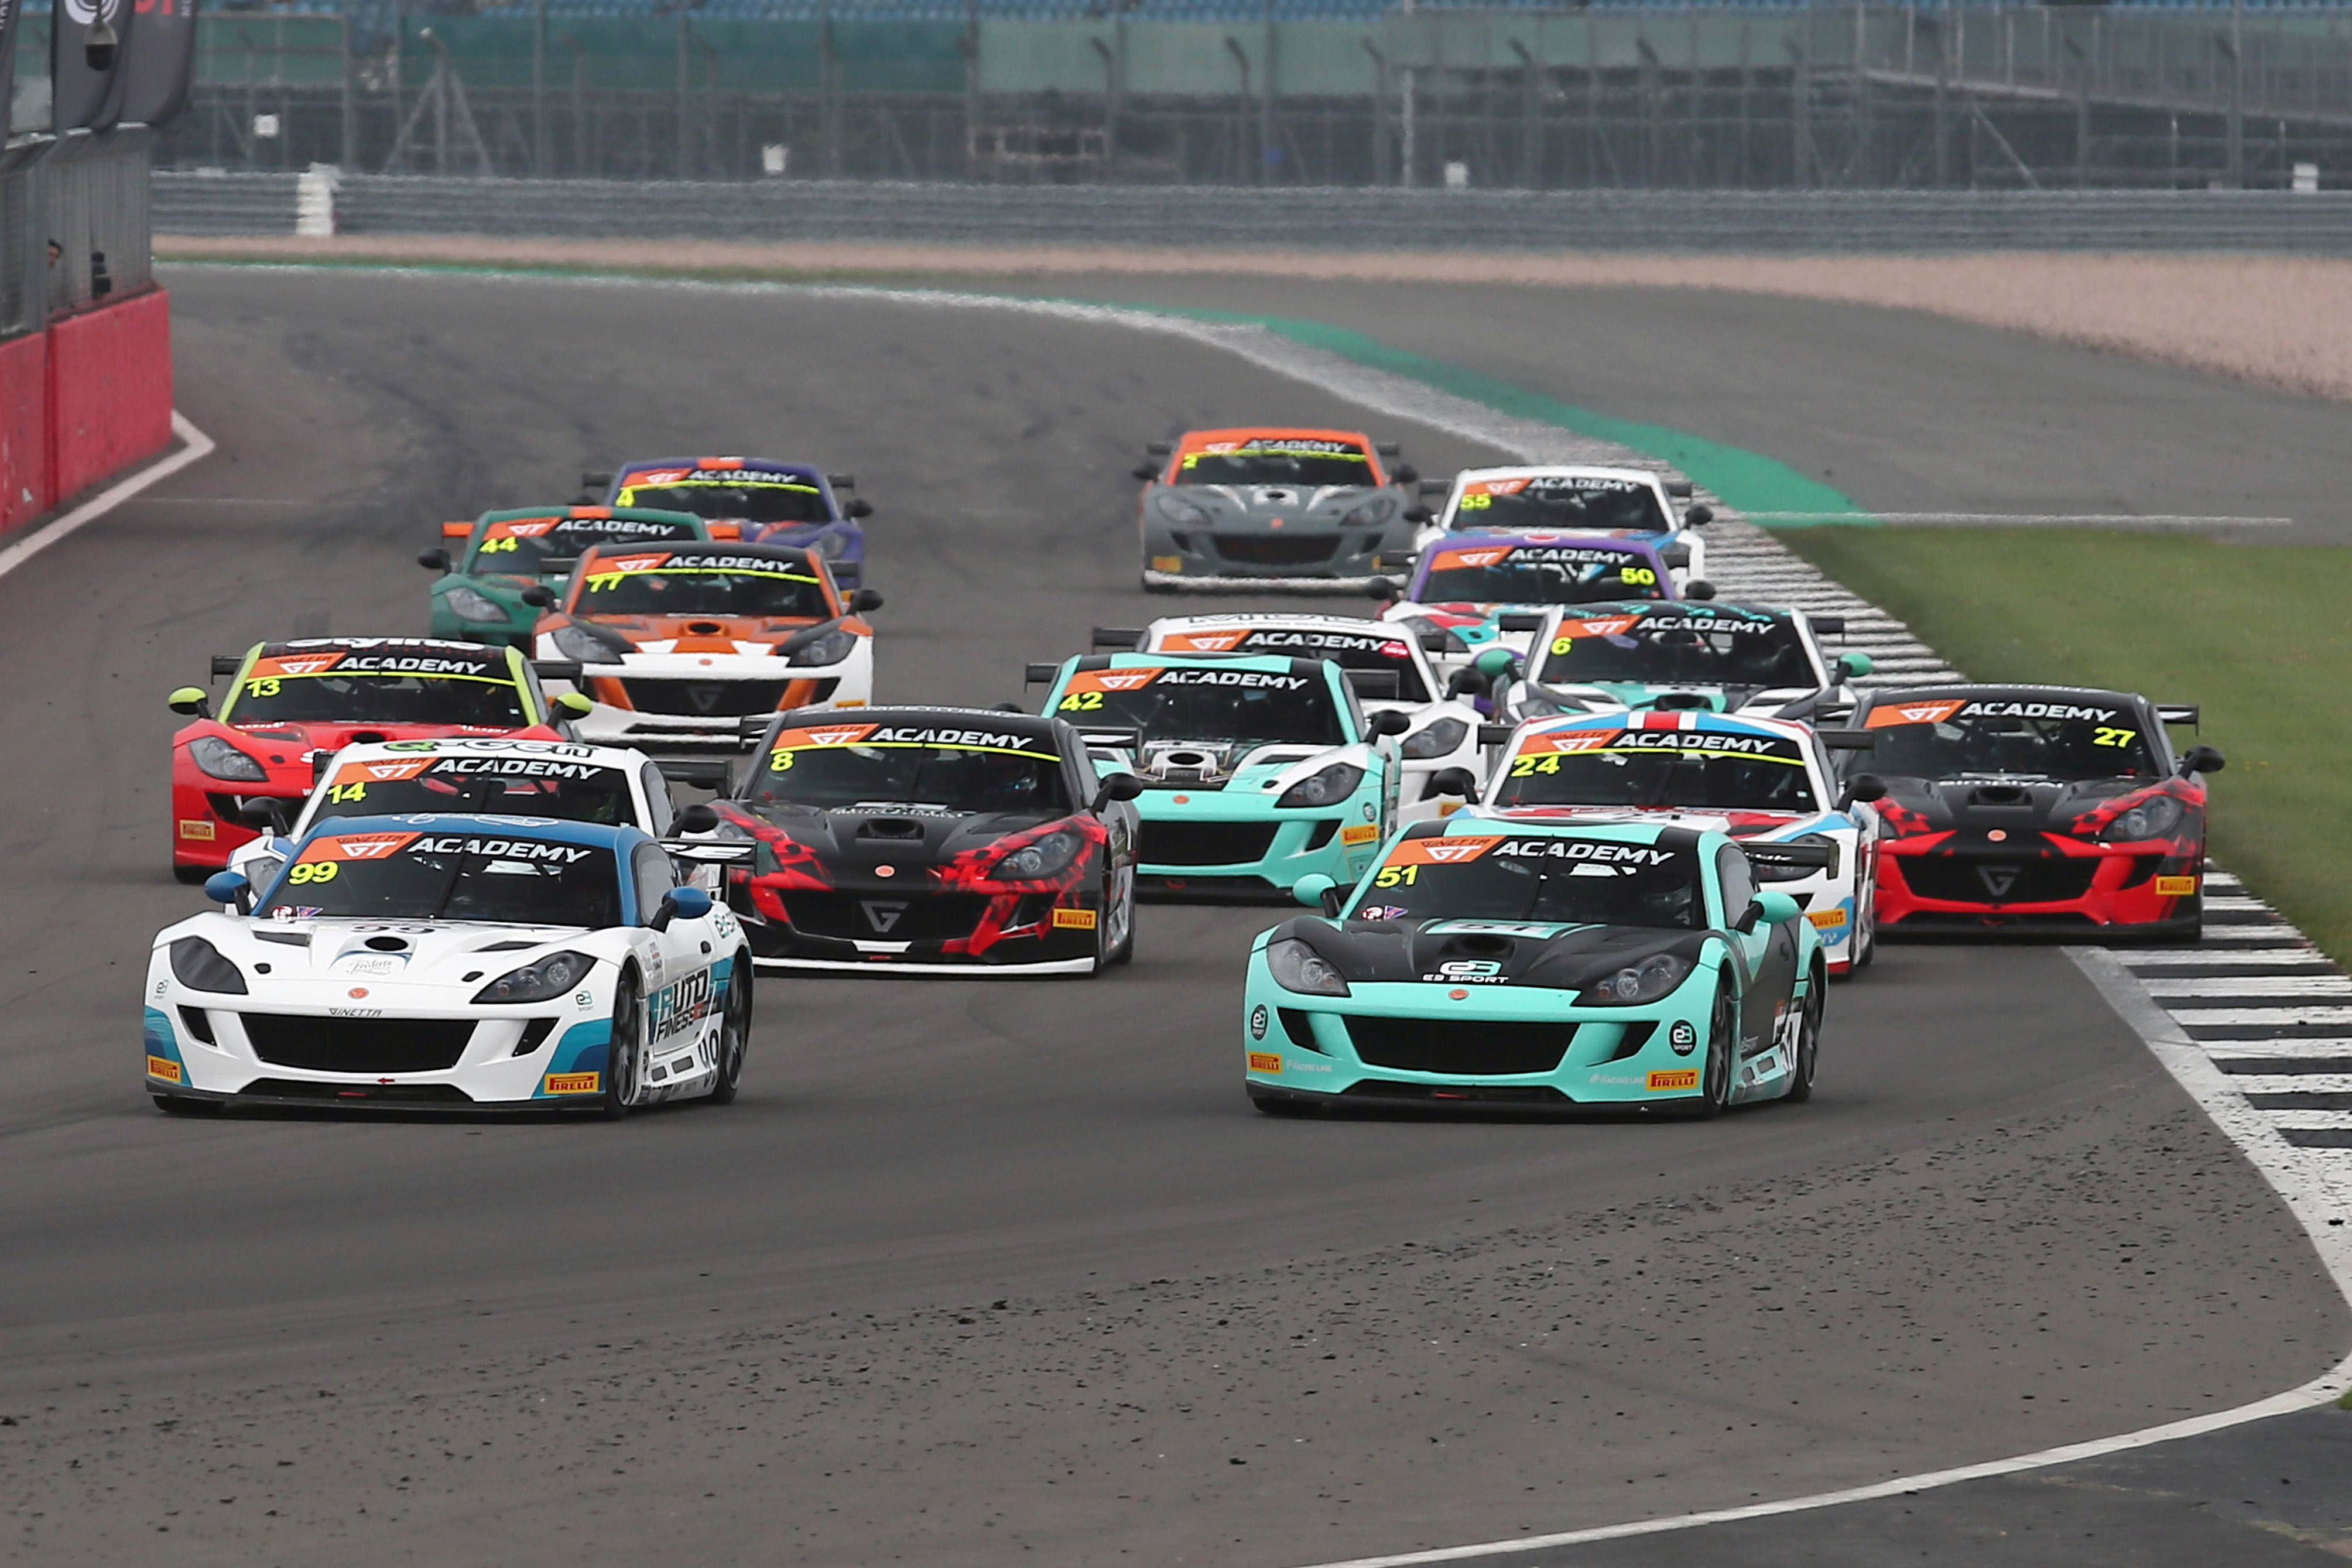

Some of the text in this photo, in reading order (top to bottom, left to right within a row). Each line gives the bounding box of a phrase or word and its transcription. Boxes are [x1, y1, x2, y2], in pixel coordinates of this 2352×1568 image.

[689, 470, 797, 482] ACADEMY
[1529, 477, 1637, 492] ACADEMY
[615, 488, 635, 507] 4
[1460, 494, 1491, 509] 55
[508, 521, 675, 535] GT ACADEMY
[479, 536, 519, 553] 44
[615, 557, 794, 571] GT ACADEMY
[1508, 549, 1634, 564] ACADEMY
[586, 574, 624, 593] 77
[1621, 567, 1655, 585] 50
[1582, 617, 1793, 634] GT ACADEMY
[1189, 638, 1235, 650] GT
[1245, 633, 1388, 651] ACADEMY
[1551, 637, 1572, 655] 6
[279, 658, 487, 675] GT ACADEMY
[245, 679, 281, 697] 13
[1098, 672, 1308, 690] GT ACADEMY
[1059, 691, 1103, 711] 42
[1899, 703, 2116, 723] GT ACADEMY
[809, 728, 1033, 749] GT ACADEMY
[1551, 733, 1776, 754] GT ACADEMY
[2093, 727, 2136, 748] 27
[367, 758, 602, 780] GT ACADEMY
[769, 752, 794, 771] 8
[1511, 755, 1560, 777] 24
[327, 782, 367, 804] 14
[341, 837, 591, 864] GT ACADEMY
[1425, 841, 1676, 867] GT ACADEMY
[289, 862, 338, 885] 99
[1375, 864, 1419, 888] 51
[1449, 975, 1509, 983] SPORT
[328, 1008, 382, 1017] GINETTA
[549, 1076, 594, 1090] PIRELLI
[1651, 1072, 1696, 1087] PIRELLI
